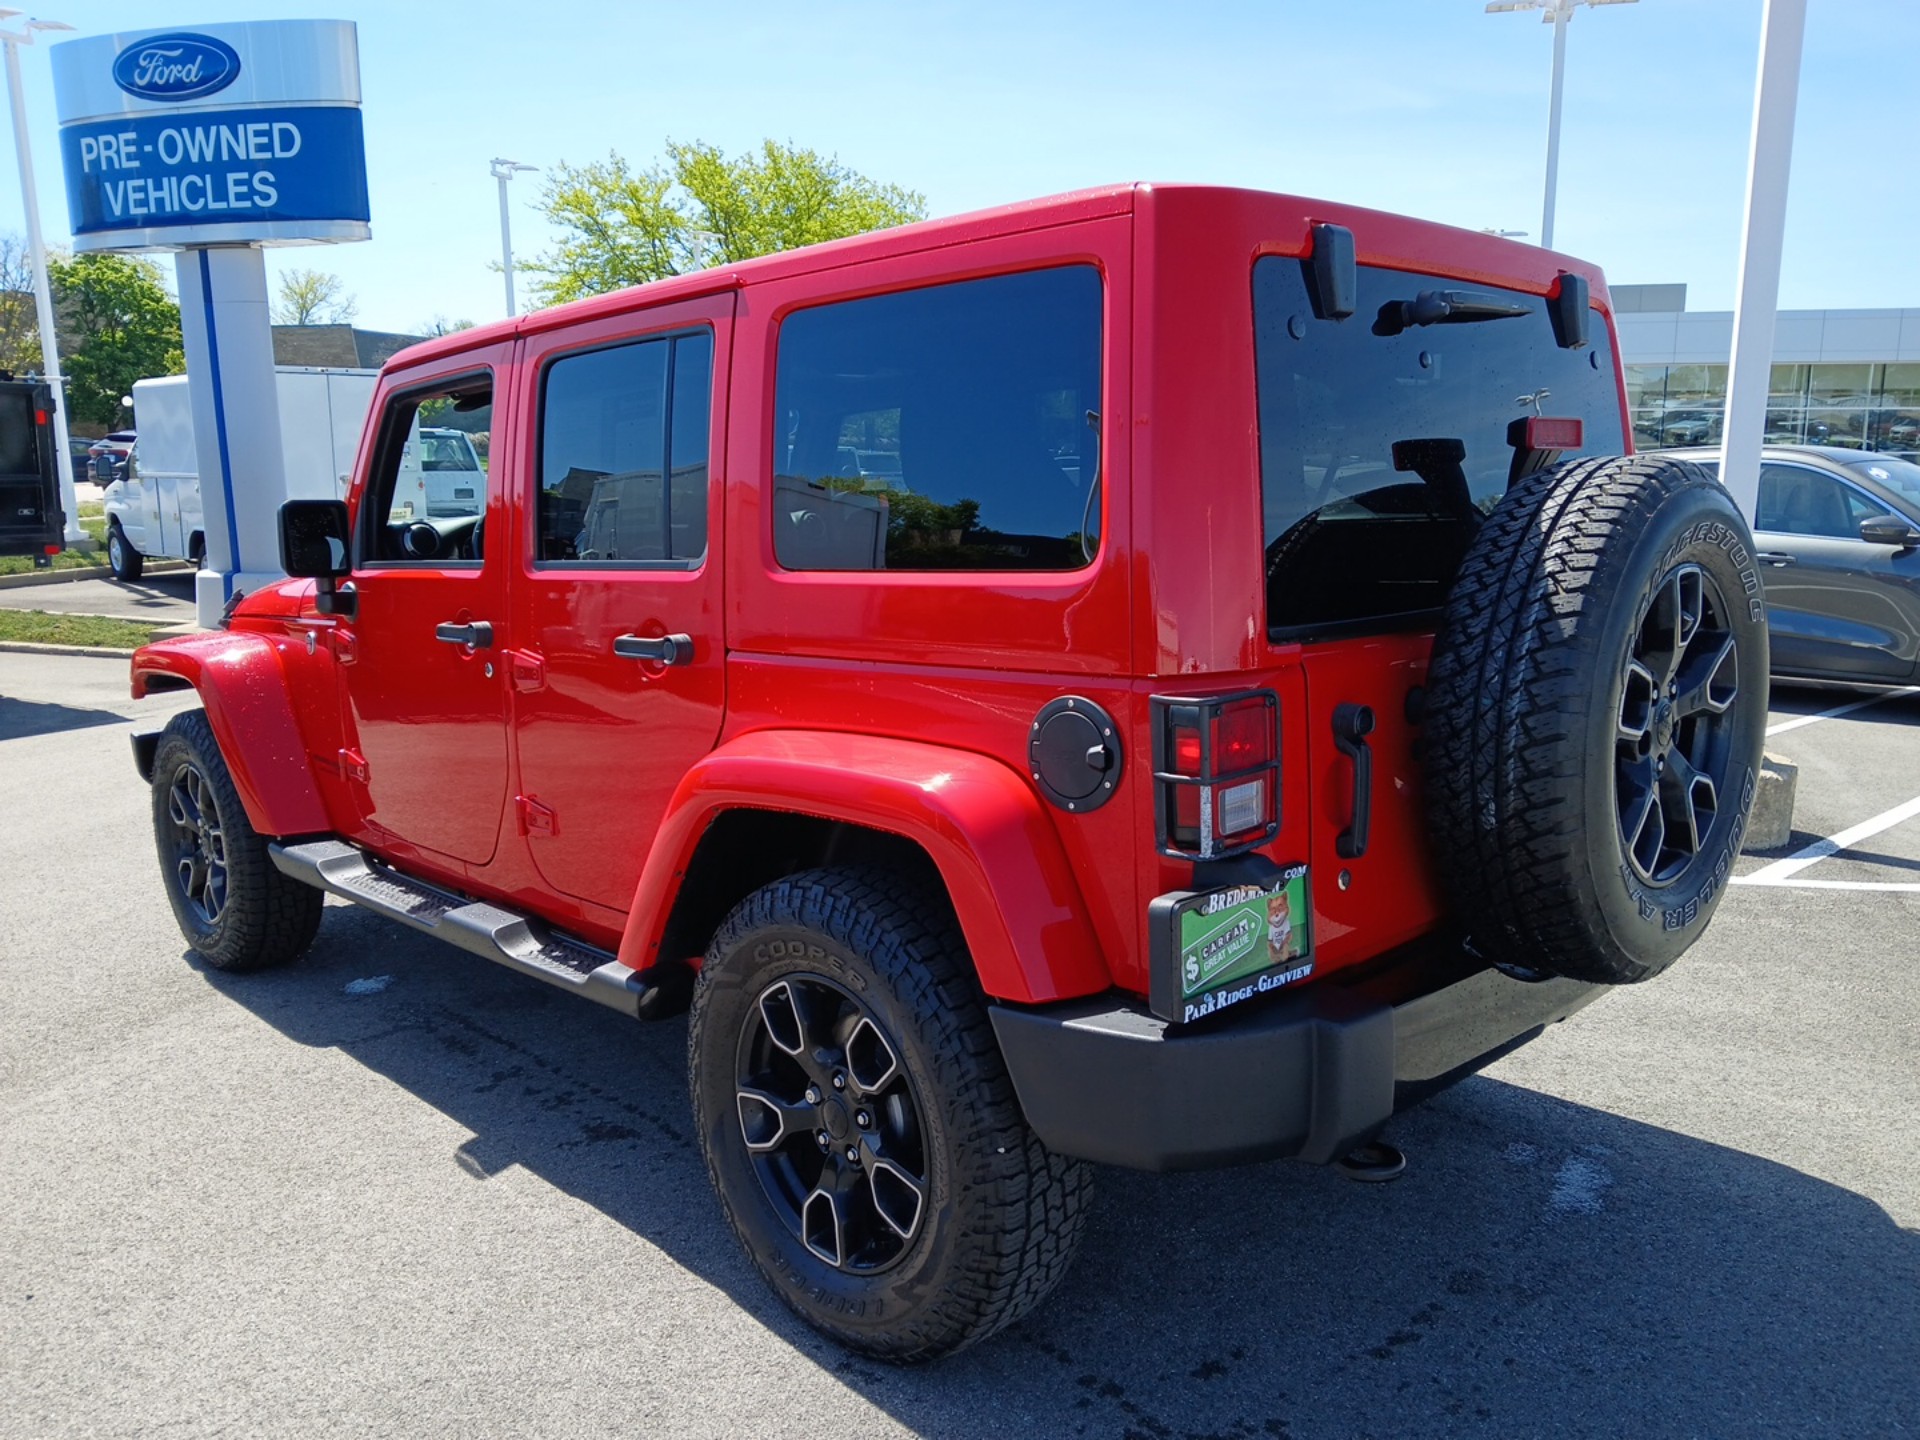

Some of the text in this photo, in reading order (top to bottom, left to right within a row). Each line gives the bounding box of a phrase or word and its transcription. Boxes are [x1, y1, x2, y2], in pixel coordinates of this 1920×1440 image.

[134, 48, 203, 86] Ford
[80, 121, 302, 173] PRE-OWNED
[104, 170, 279, 216] VEHICLES
[1208, 880, 1281, 914] BREDEMA
[1202, 919, 1249, 958] CARFAX
[1203, 933, 1250, 972] GREAT VALUE
[753, 940, 867, 992] COOPER
[1186, 954, 1200, 981] $
[1183, 998, 1216, 1024] PARK
